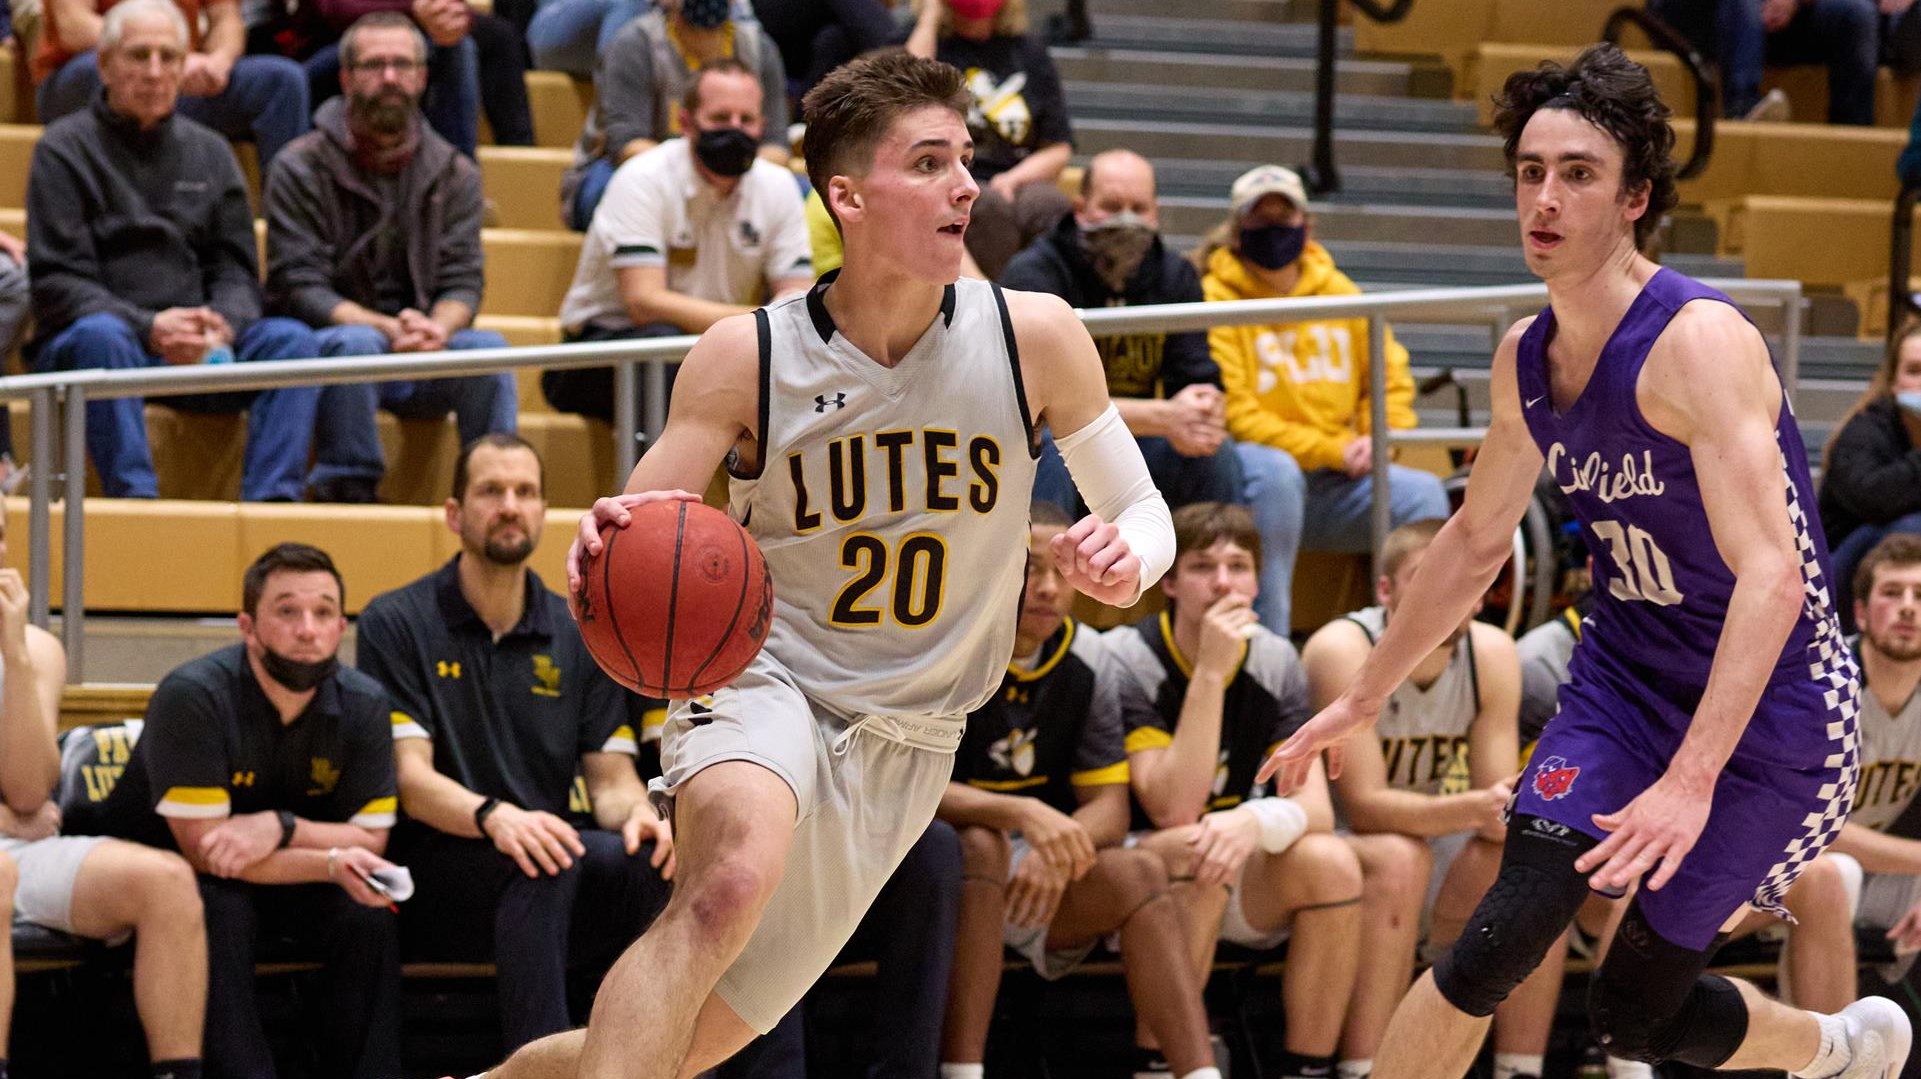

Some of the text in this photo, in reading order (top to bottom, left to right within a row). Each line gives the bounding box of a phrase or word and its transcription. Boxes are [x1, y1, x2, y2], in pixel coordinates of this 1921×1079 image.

[1255, 322, 1351, 395] PLU
[787, 426, 1001, 536] LUTES
[828, 531, 949, 630] 20
[1590, 519, 1684, 607] 30
[1381, 734, 1469, 784] UTE
